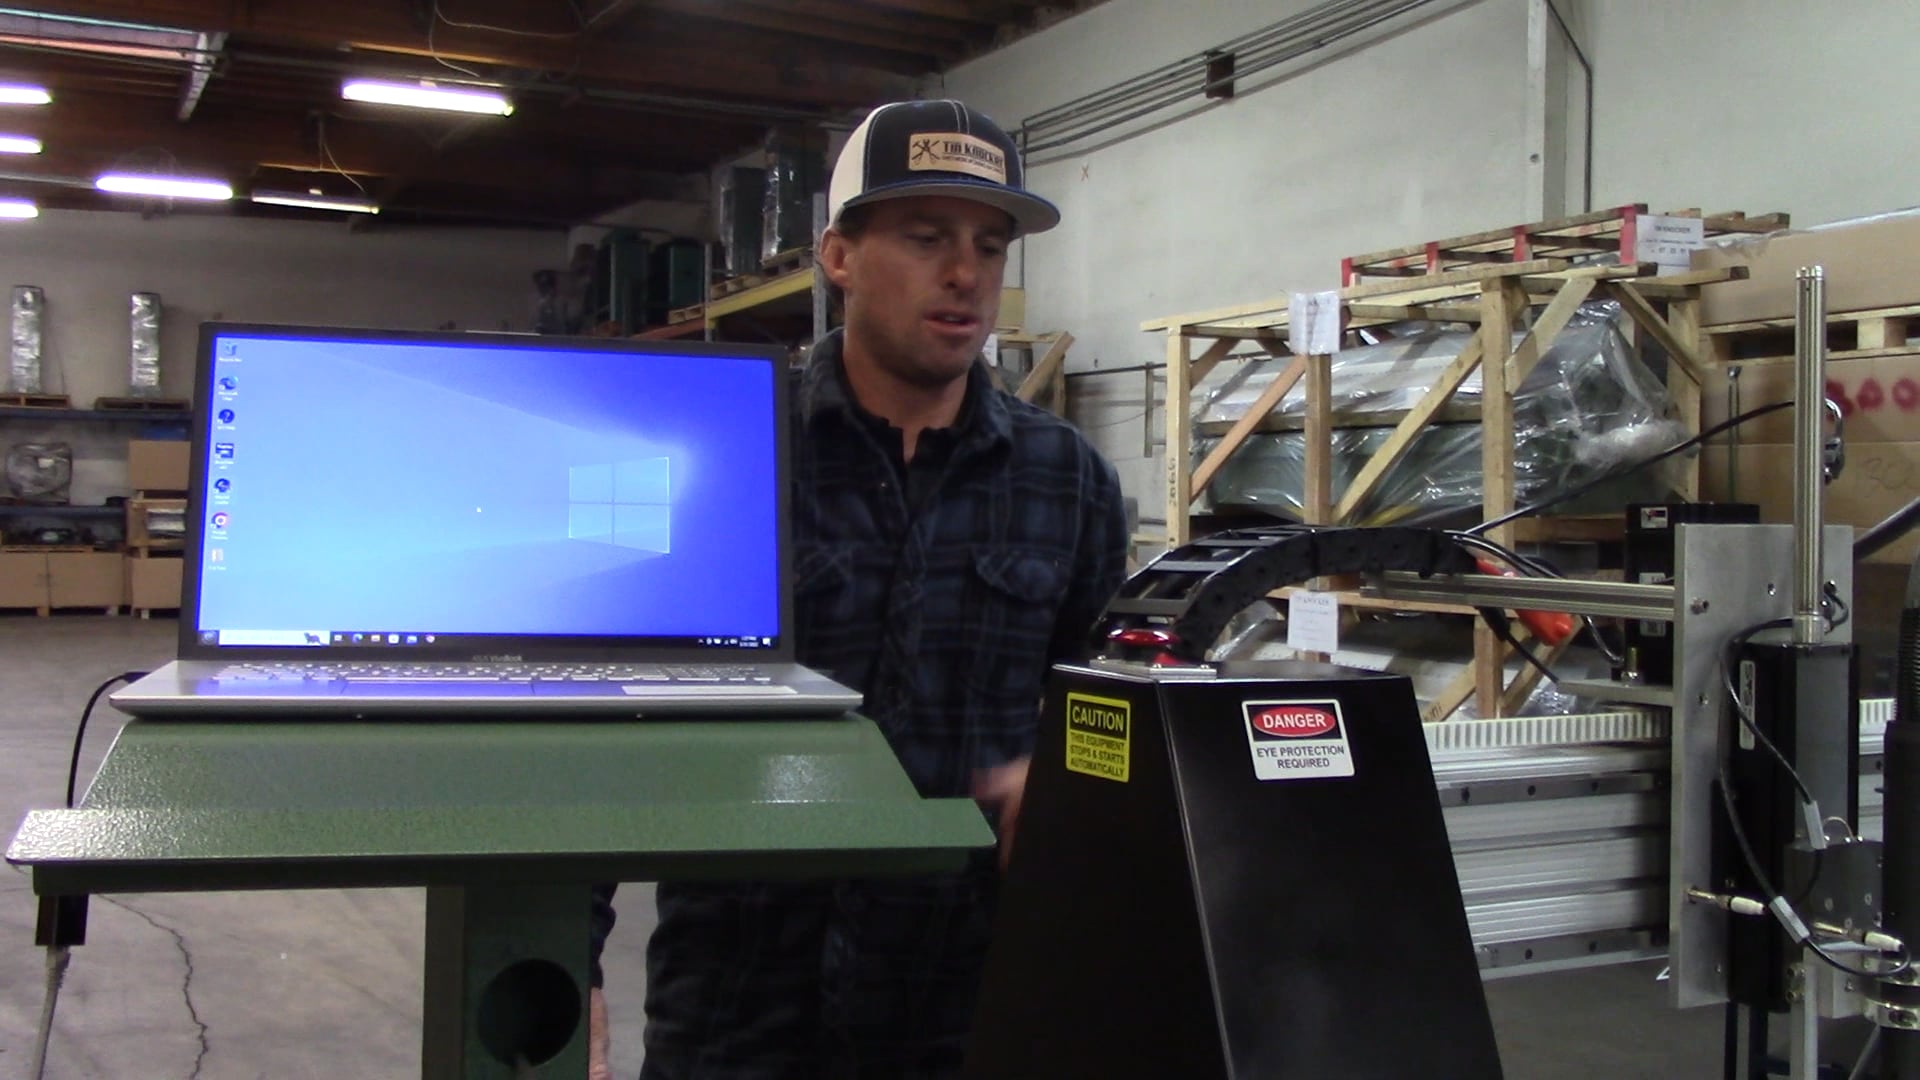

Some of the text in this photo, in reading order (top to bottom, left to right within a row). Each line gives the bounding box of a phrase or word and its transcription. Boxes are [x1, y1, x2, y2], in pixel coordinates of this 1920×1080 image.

[1072, 705, 1124, 732] CAUTION
[1262, 713, 1327, 729] DANGER
[1070, 732, 1125, 751] THIS EQUIPMENT
[1070, 744, 1091, 758] STOPS
[1099, 750, 1125, 765] STARTS
[1256, 745, 1345, 758] EYE PROTECTION
[1070, 758, 1125, 778] AUTOMATICALLY
[1277, 758, 1330, 769] REQUIRED
